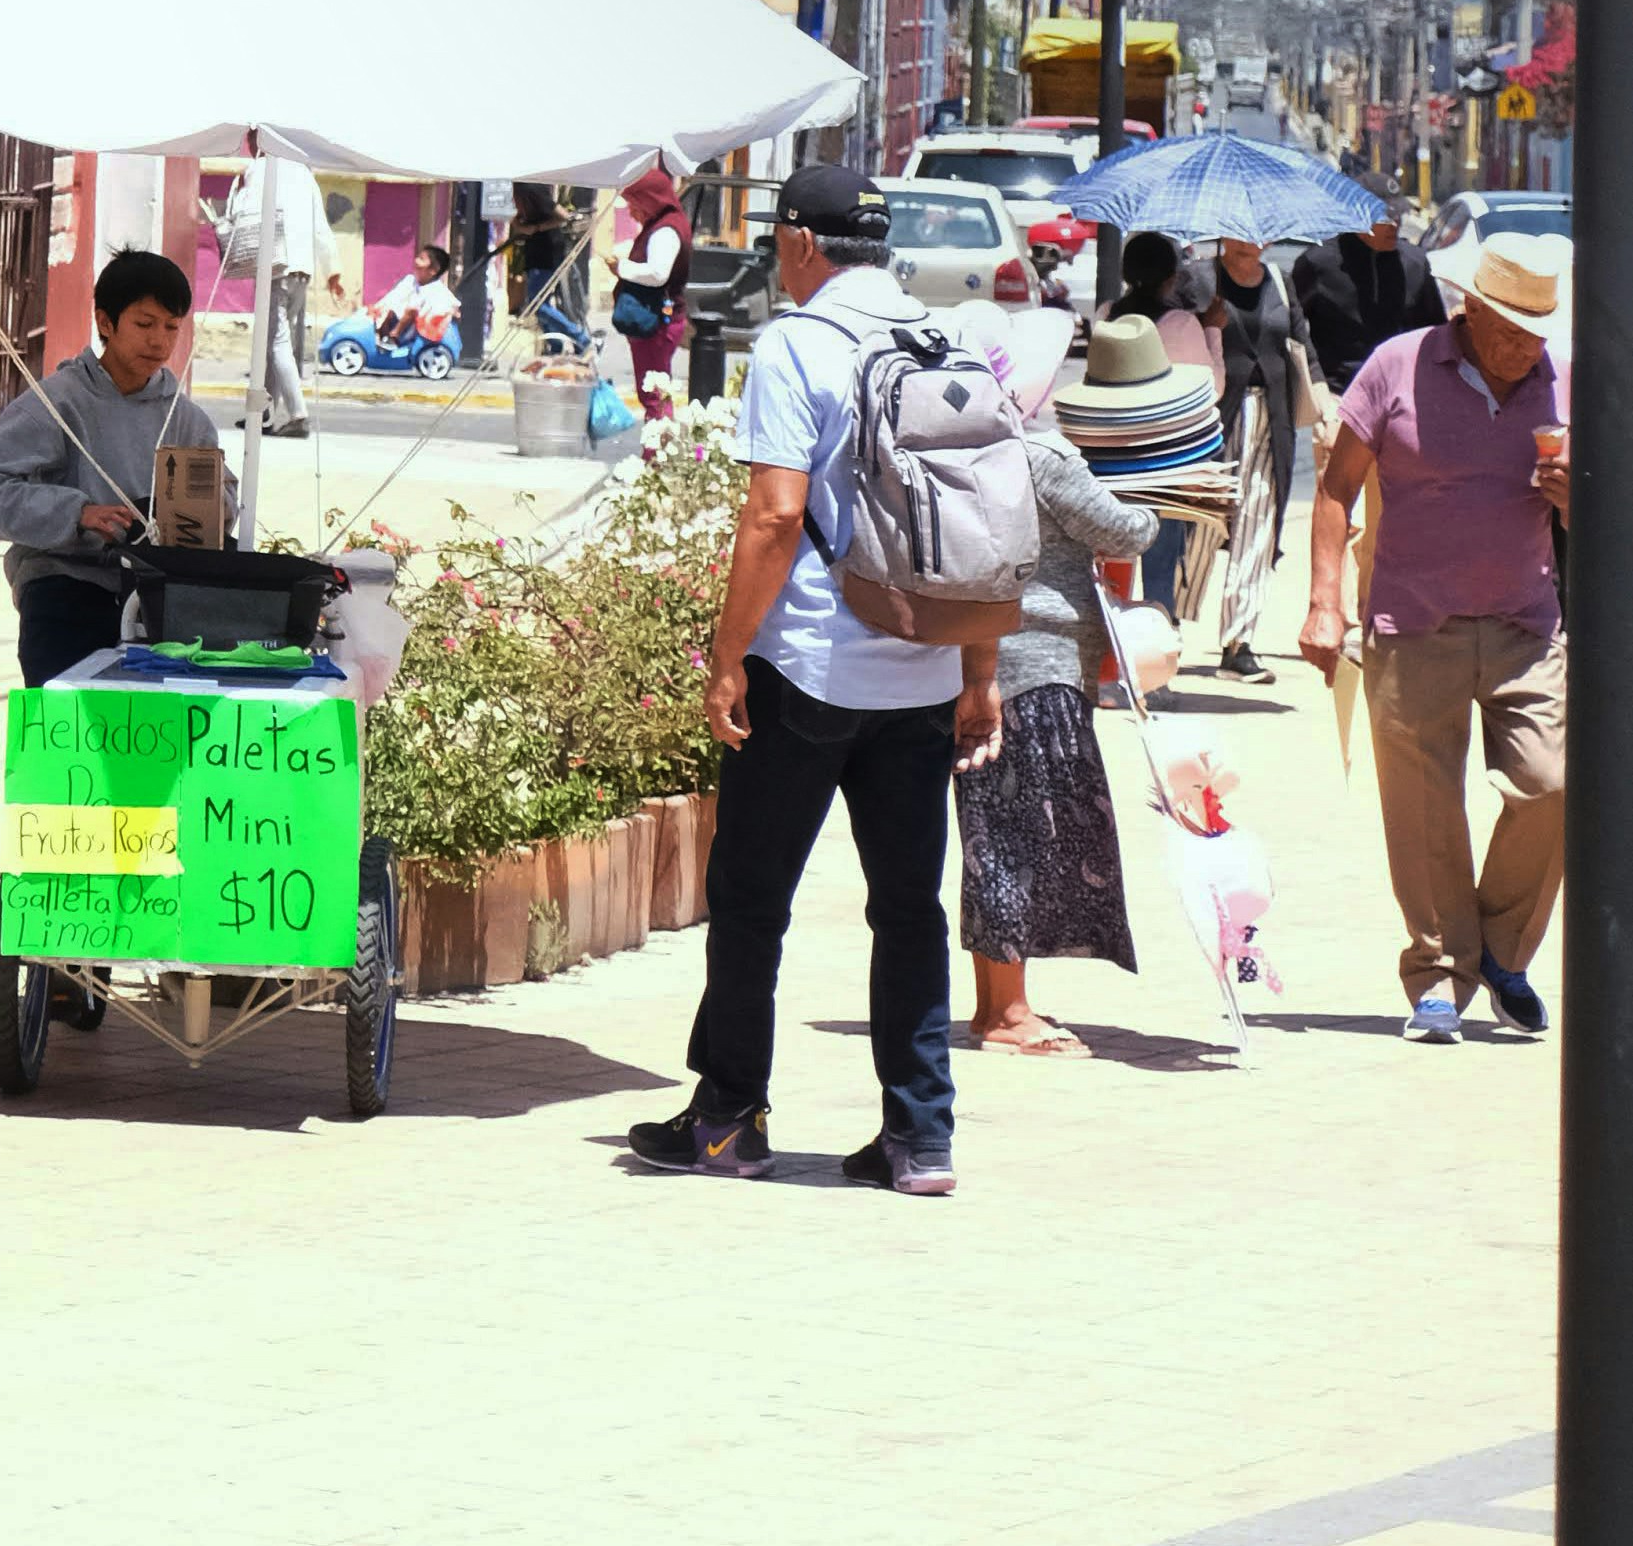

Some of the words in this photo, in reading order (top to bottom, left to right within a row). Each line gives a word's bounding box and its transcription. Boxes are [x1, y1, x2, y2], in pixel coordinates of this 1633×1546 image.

[20, 694, 177, 763] Helados
[187, 703, 336, 775] Paletas
[18, 810, 106, 857] Frutos
[113, 809, 176, 862] Rojos
[204, 796, 292, 845] Mini
[7, 874, 111, 916] Galleta
[117, 873, 178, 916] Oreo
[217, 867, 315, 935] $10
